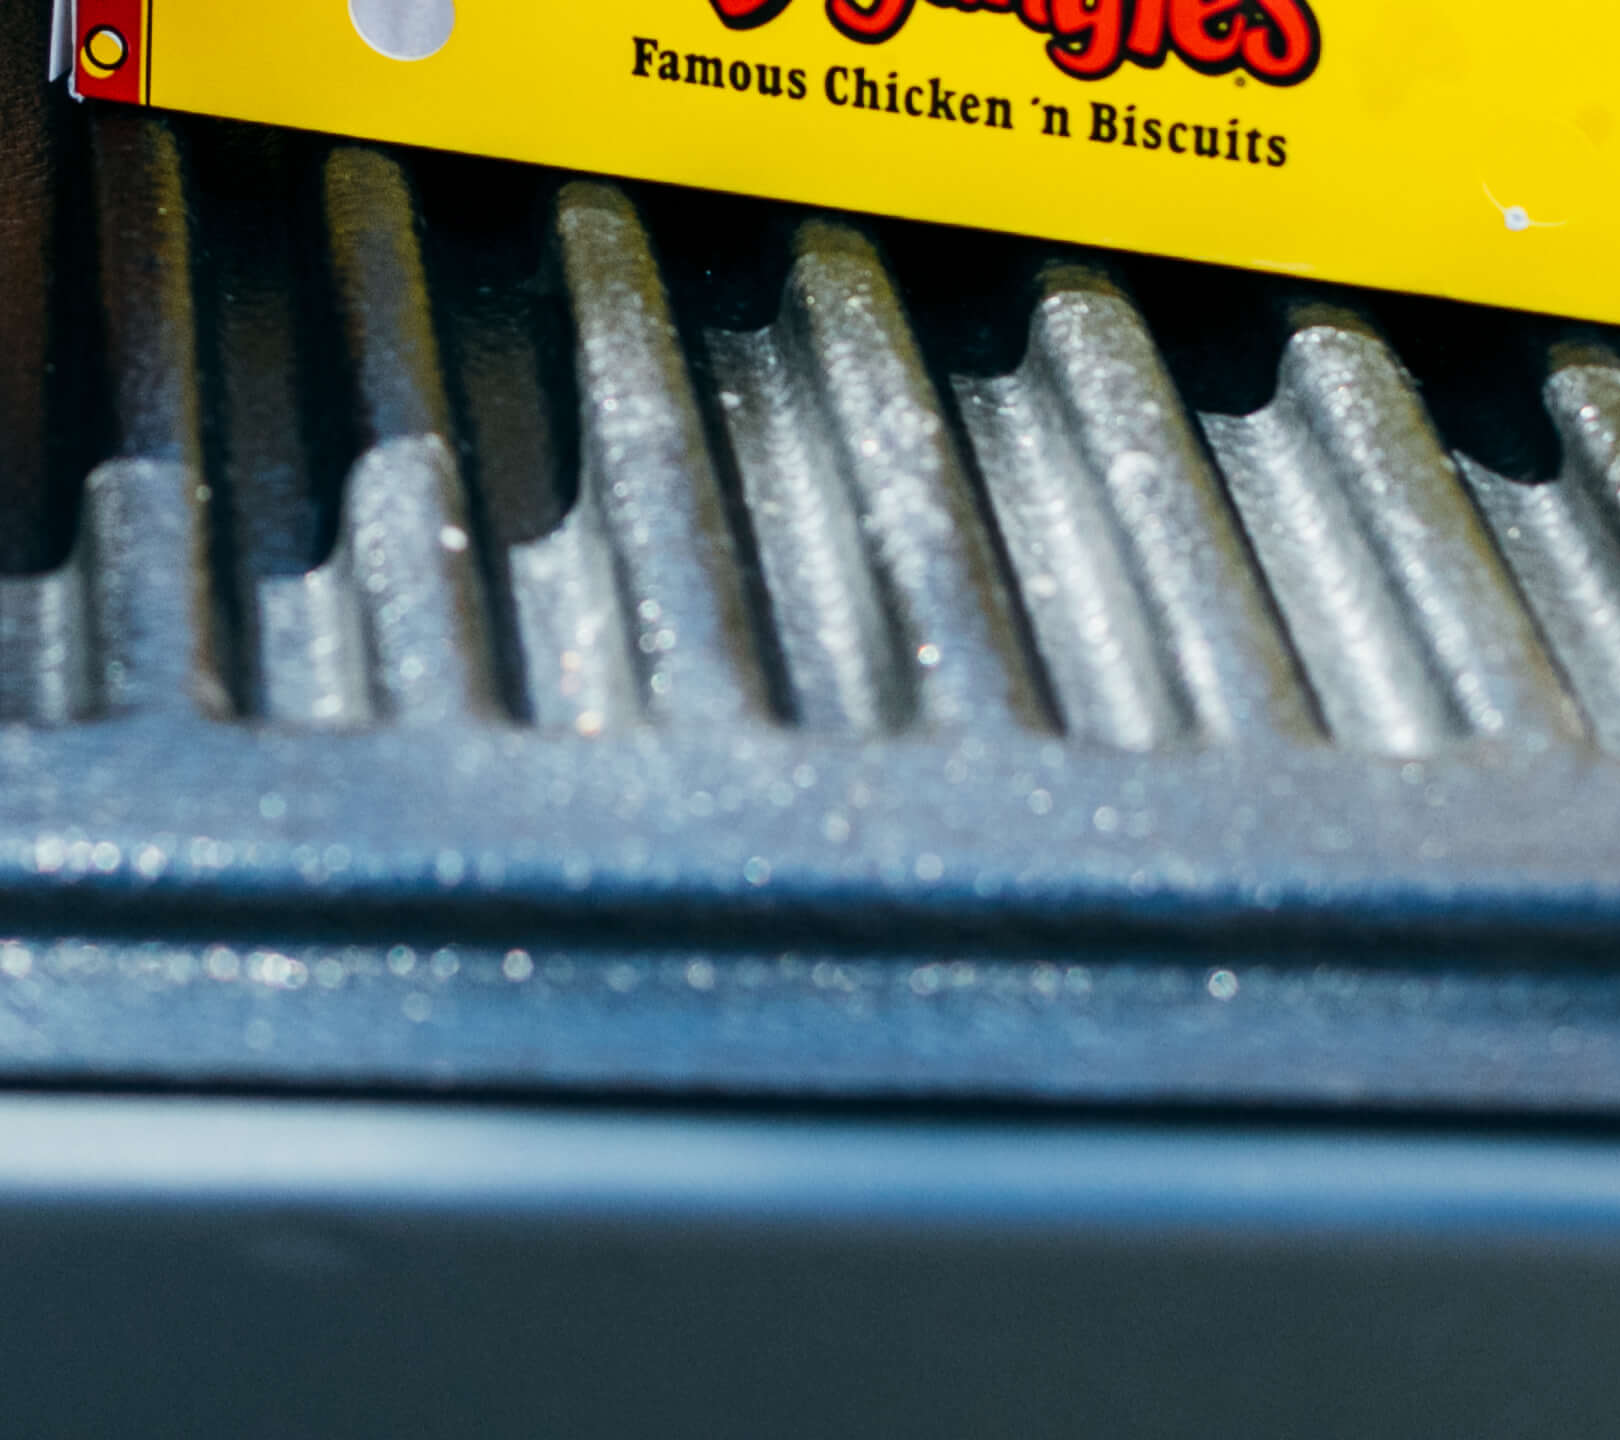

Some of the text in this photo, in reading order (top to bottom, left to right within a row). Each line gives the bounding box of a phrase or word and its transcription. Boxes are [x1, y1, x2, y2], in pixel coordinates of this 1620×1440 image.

[632, 36, 807, 101] Famous
[824, 66, 1014, 130] Chicken
[1089, 103, 1288, 168] Biscuits
